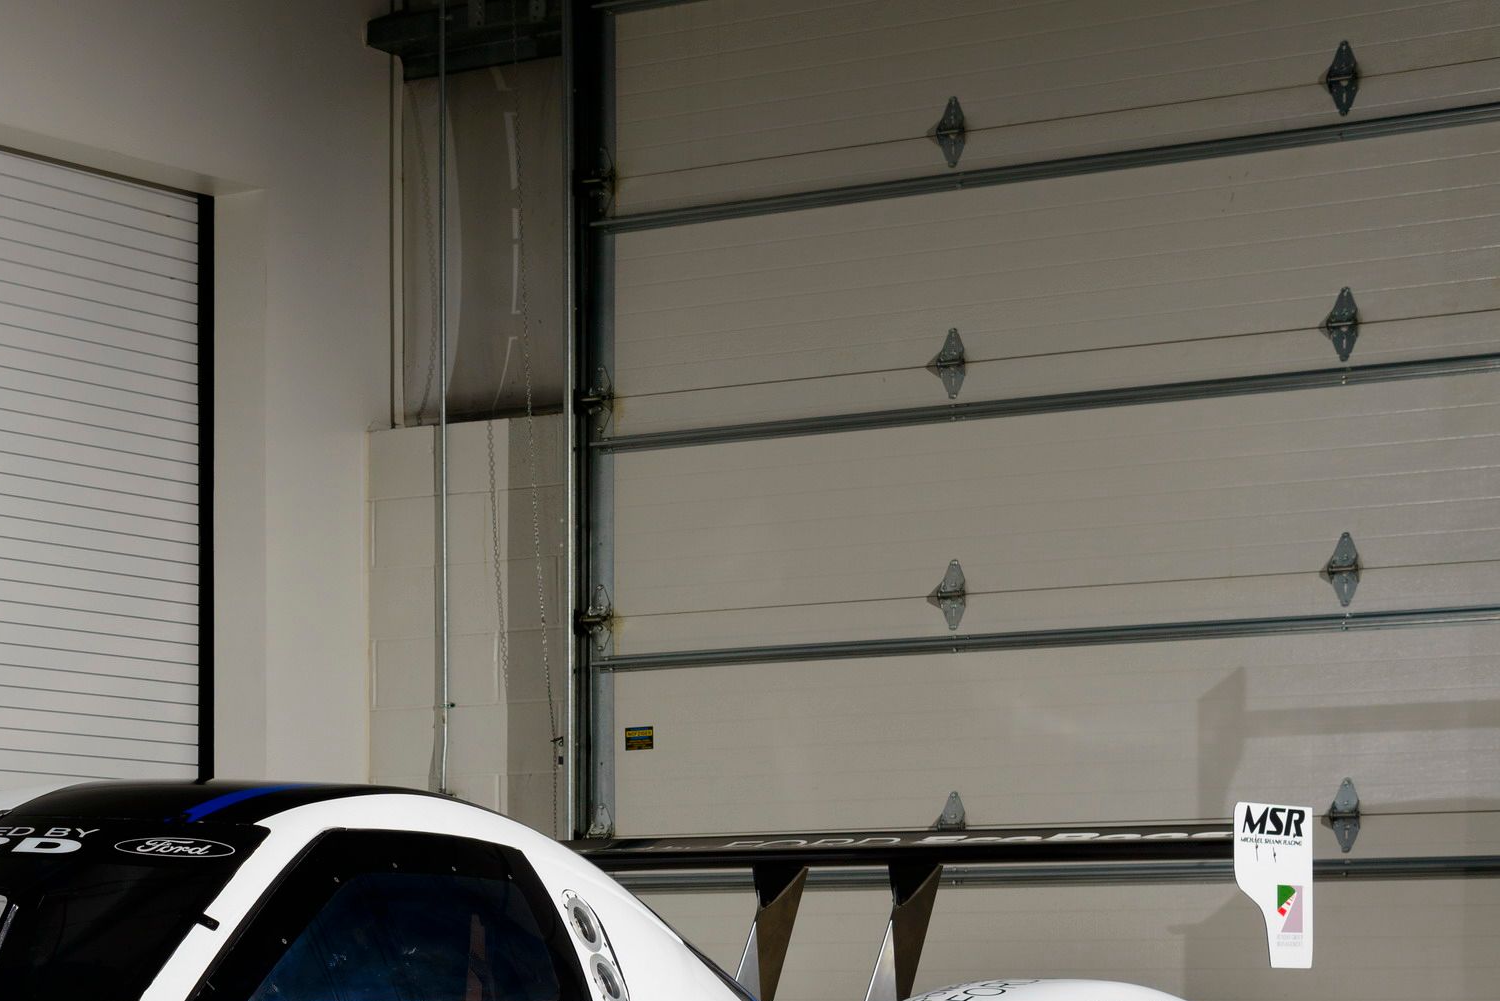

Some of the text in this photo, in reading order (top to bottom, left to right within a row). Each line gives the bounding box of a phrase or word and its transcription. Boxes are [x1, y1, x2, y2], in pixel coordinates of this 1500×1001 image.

[1242, 805, 1305, 837] MSR
[43, 827, 100, 838] BY
[912, 831, 1233, 845] EcoBoos
[137, 839, 212, 855] Ford
